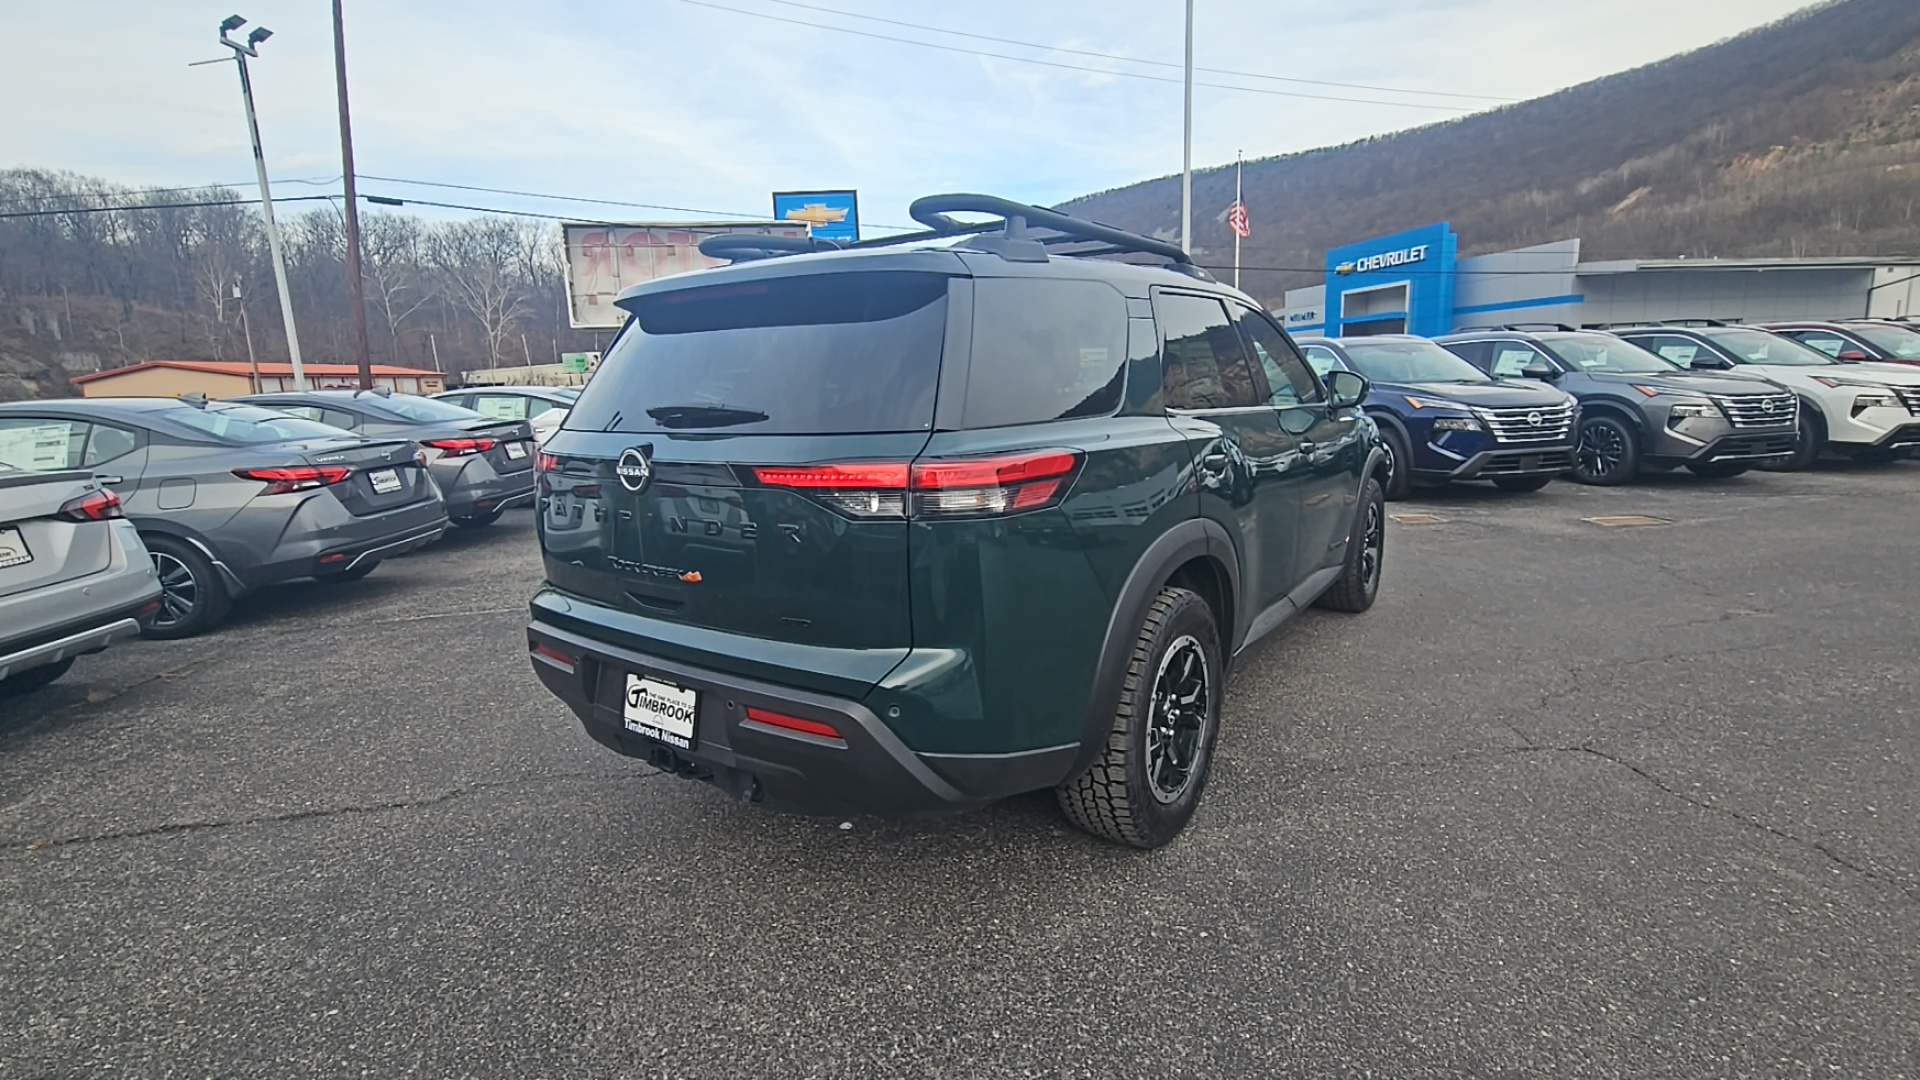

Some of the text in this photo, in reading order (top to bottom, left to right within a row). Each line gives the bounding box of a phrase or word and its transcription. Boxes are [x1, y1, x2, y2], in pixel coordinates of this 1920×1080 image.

[1357, 245, 1429, 272] CHEVROLET
[616, 466, 649, 477] NISSAN
[627, 684, 696, 724] TIMBROOK
[667, 697, 680, 707] PLACE
[624, 718, 690, 750] Timbrook Nissan
